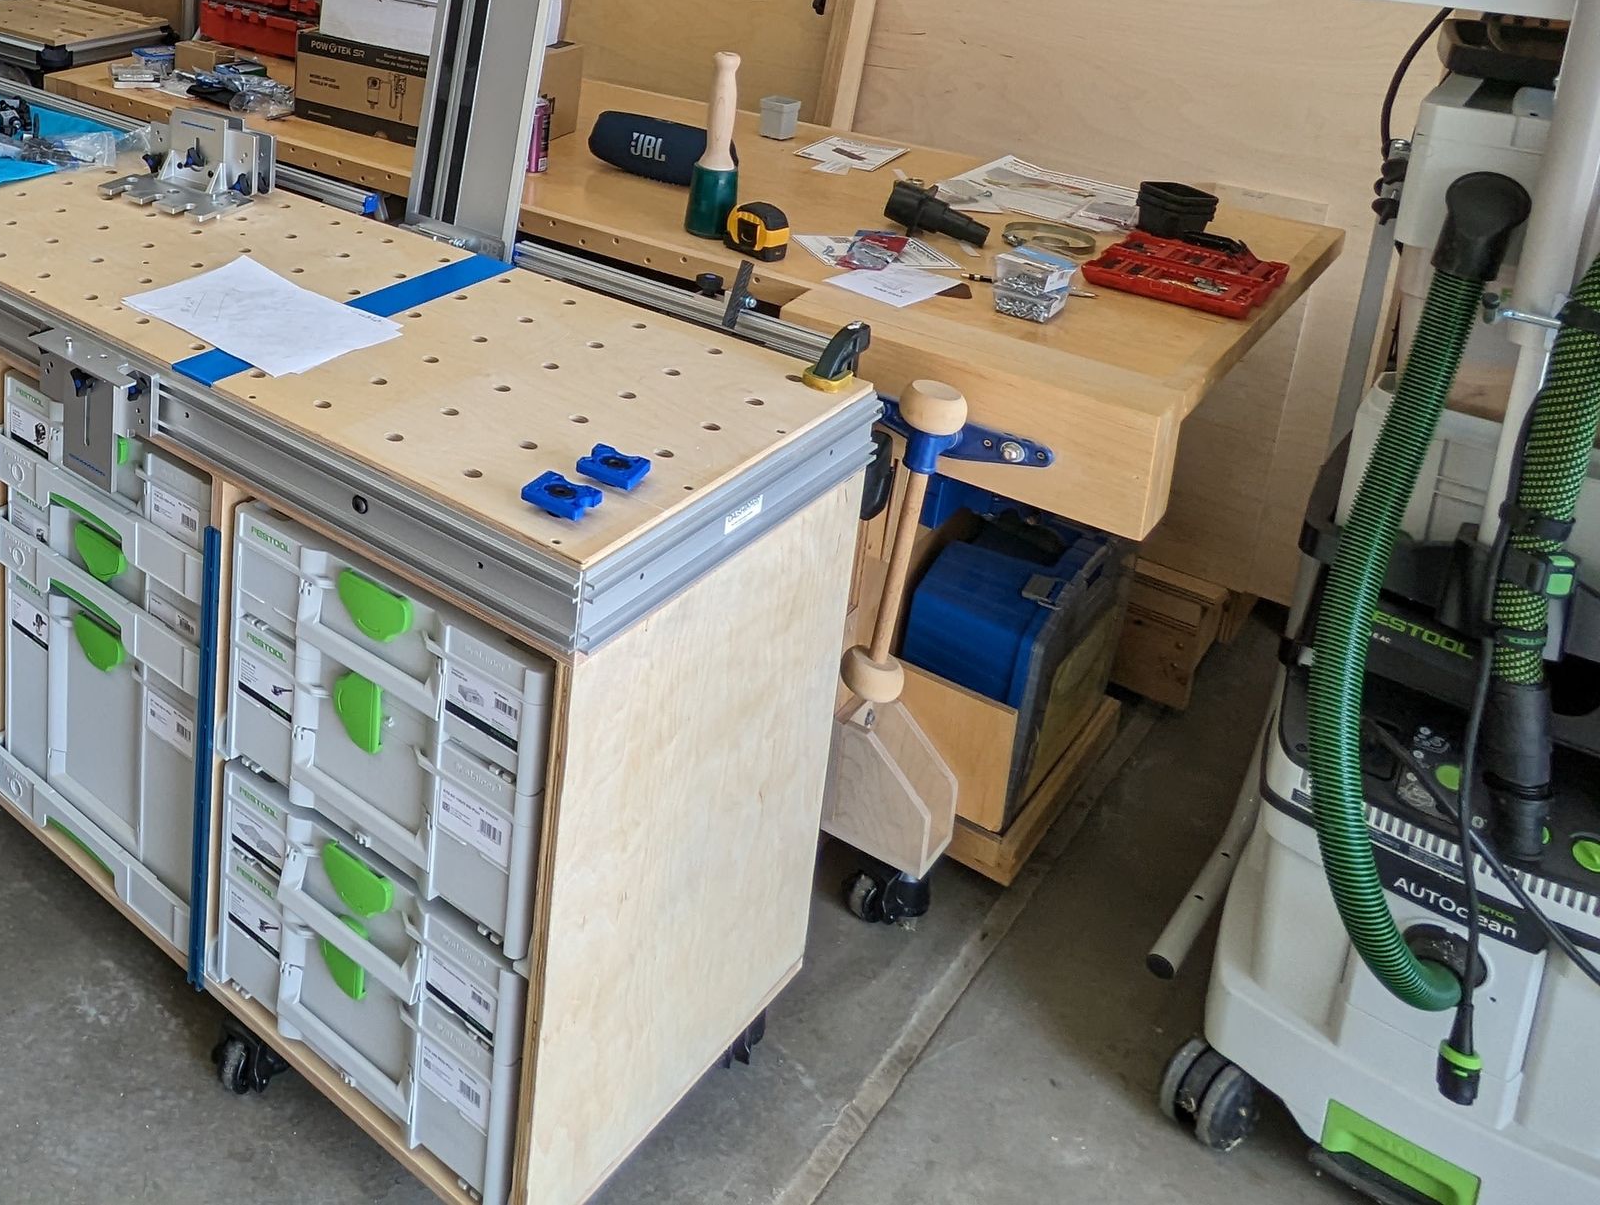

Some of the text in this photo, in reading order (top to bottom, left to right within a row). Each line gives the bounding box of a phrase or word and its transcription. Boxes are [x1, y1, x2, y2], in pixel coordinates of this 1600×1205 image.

[630, 131, 666, 162] JBL
[16, 386, 45, 409] FESTOOL
[251, 525, 292, 556] FESTOOL
[246, 631, 288, 664] FESTOOL
[1372, 609, 1474, 661] ESTOOL
[239, 786, 279, 821] FESTOOL
[236, 864, 275, 901] FESTOOL
[1393, 876, 1518, 940] AUTOcean
